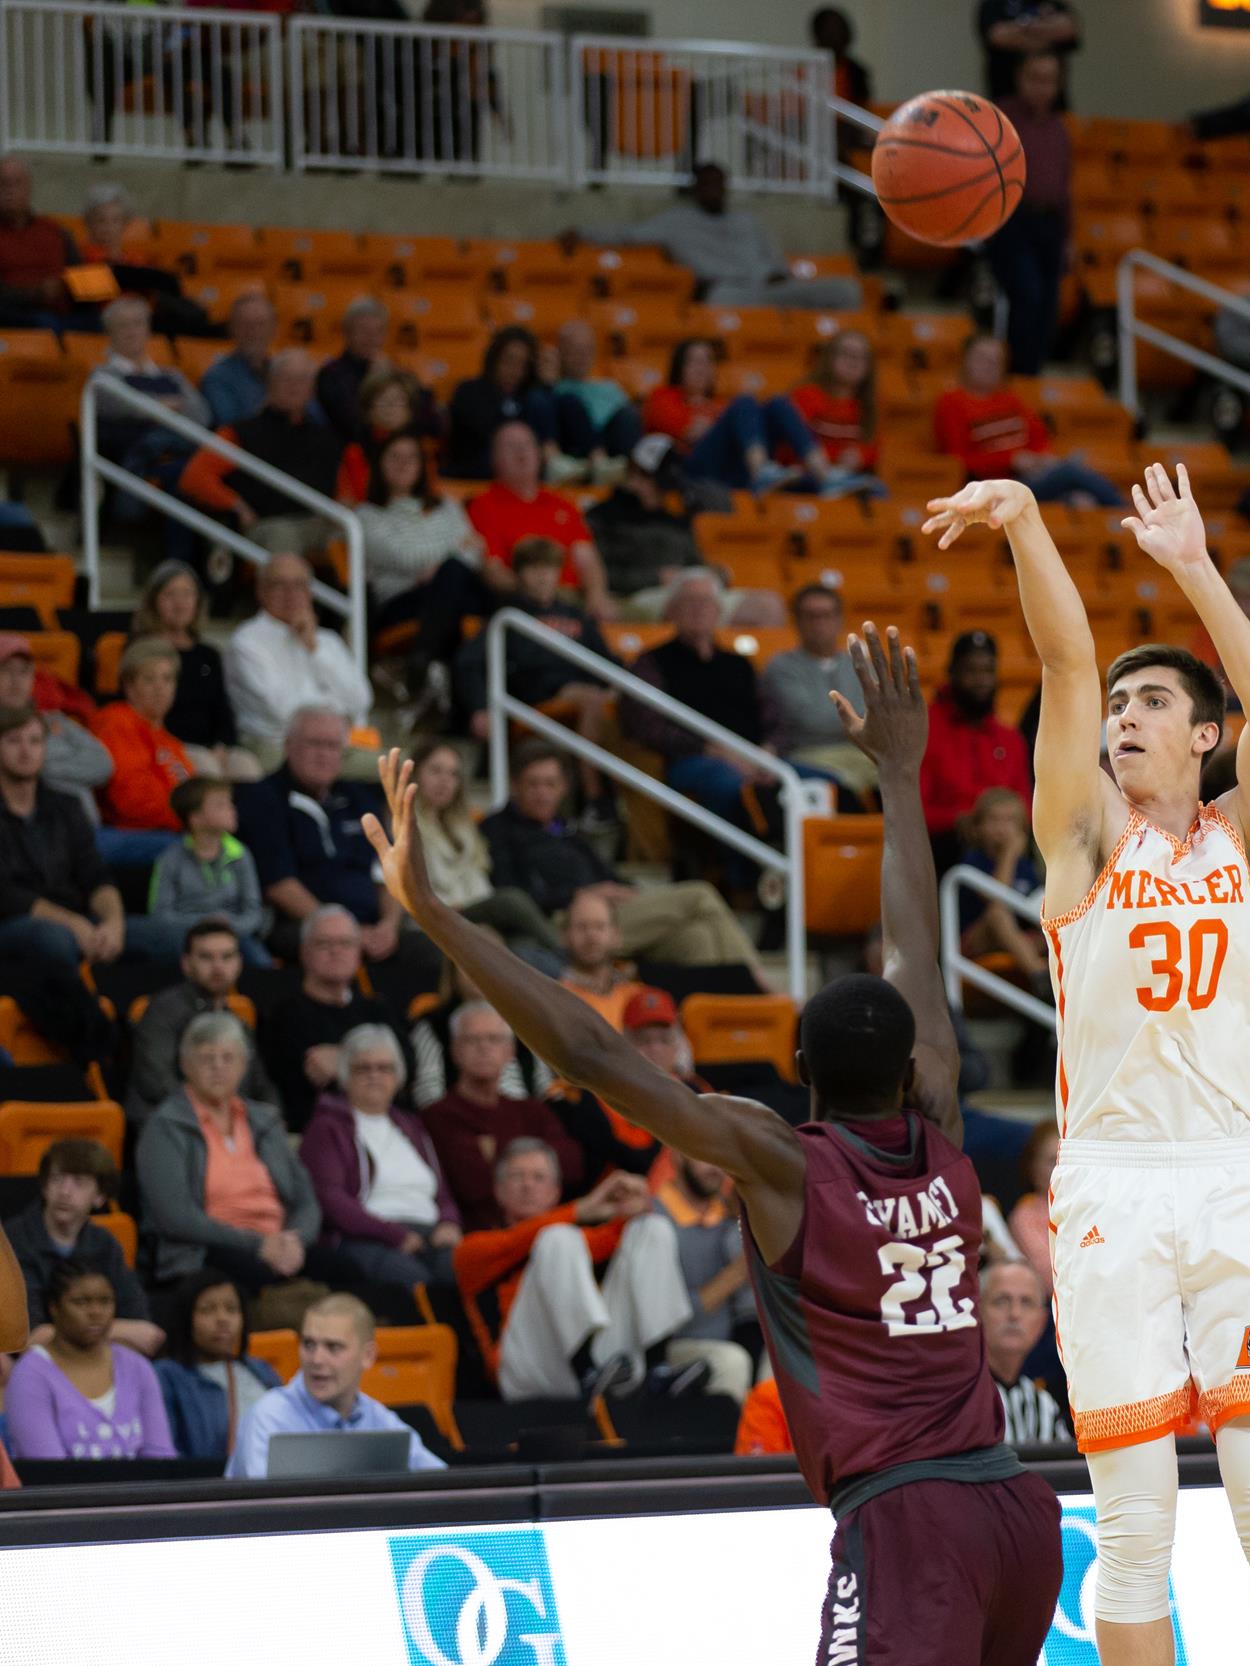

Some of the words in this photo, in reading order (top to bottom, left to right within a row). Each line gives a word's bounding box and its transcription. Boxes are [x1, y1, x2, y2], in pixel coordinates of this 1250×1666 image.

[1107, 864, 1244, 909] MERCER
[1129, 918, 1228, 1012] 30
[878, 1234, 977, 1337] 22
[1080, 1237, 1105, 1248] adidas
[827, 1572, 861, 1666] WKS
